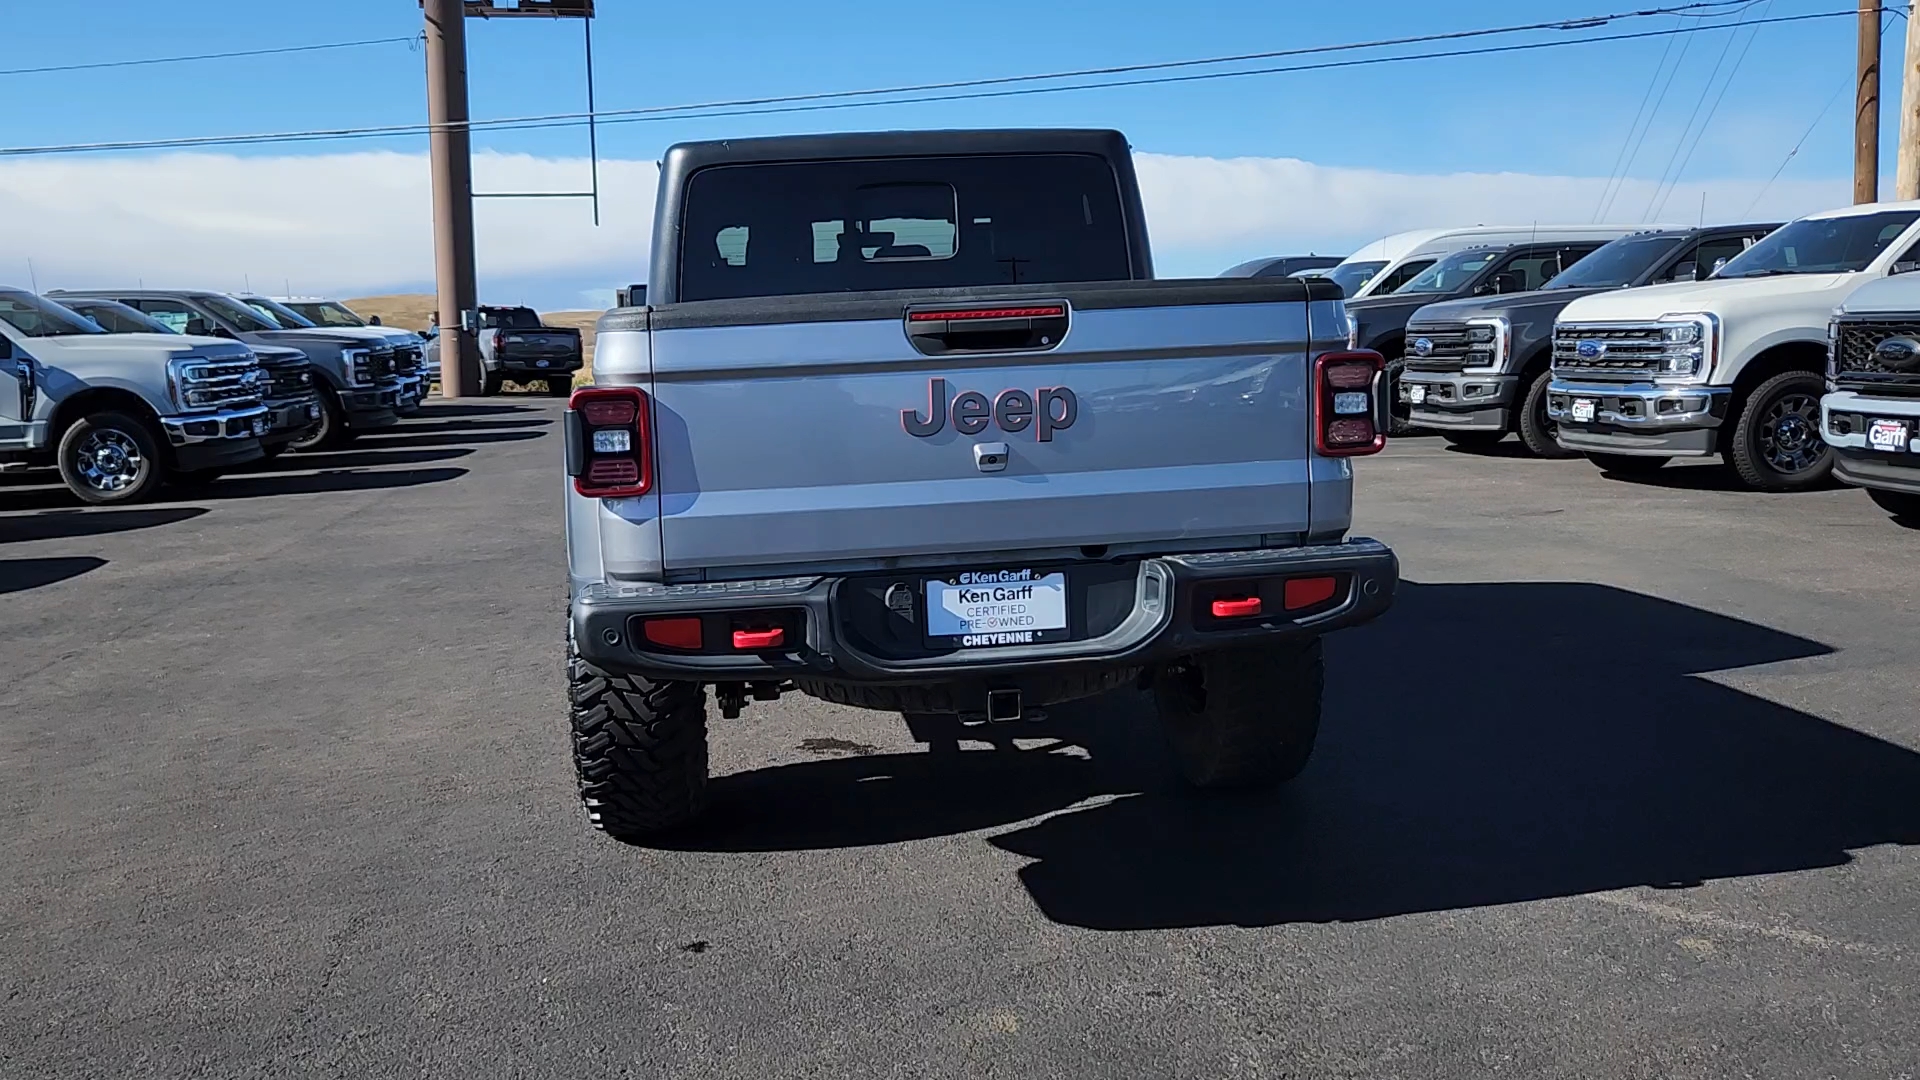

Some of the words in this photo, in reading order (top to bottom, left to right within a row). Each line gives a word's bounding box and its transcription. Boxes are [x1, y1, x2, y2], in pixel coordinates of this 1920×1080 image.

[900, 376, 1078, 443] Jeep
[1869, 424, 1908, 448] Garff
[971, 571, 998, 583] Ken
[998, 569, 1032, 582] Garff
[959, 588, 990, 604] Ken
[993, 585, 1033, 602] Garff
[966, 604, 1026, 618] CERTIFIED
[962, 631, 1033, 647] CHEYENNE
